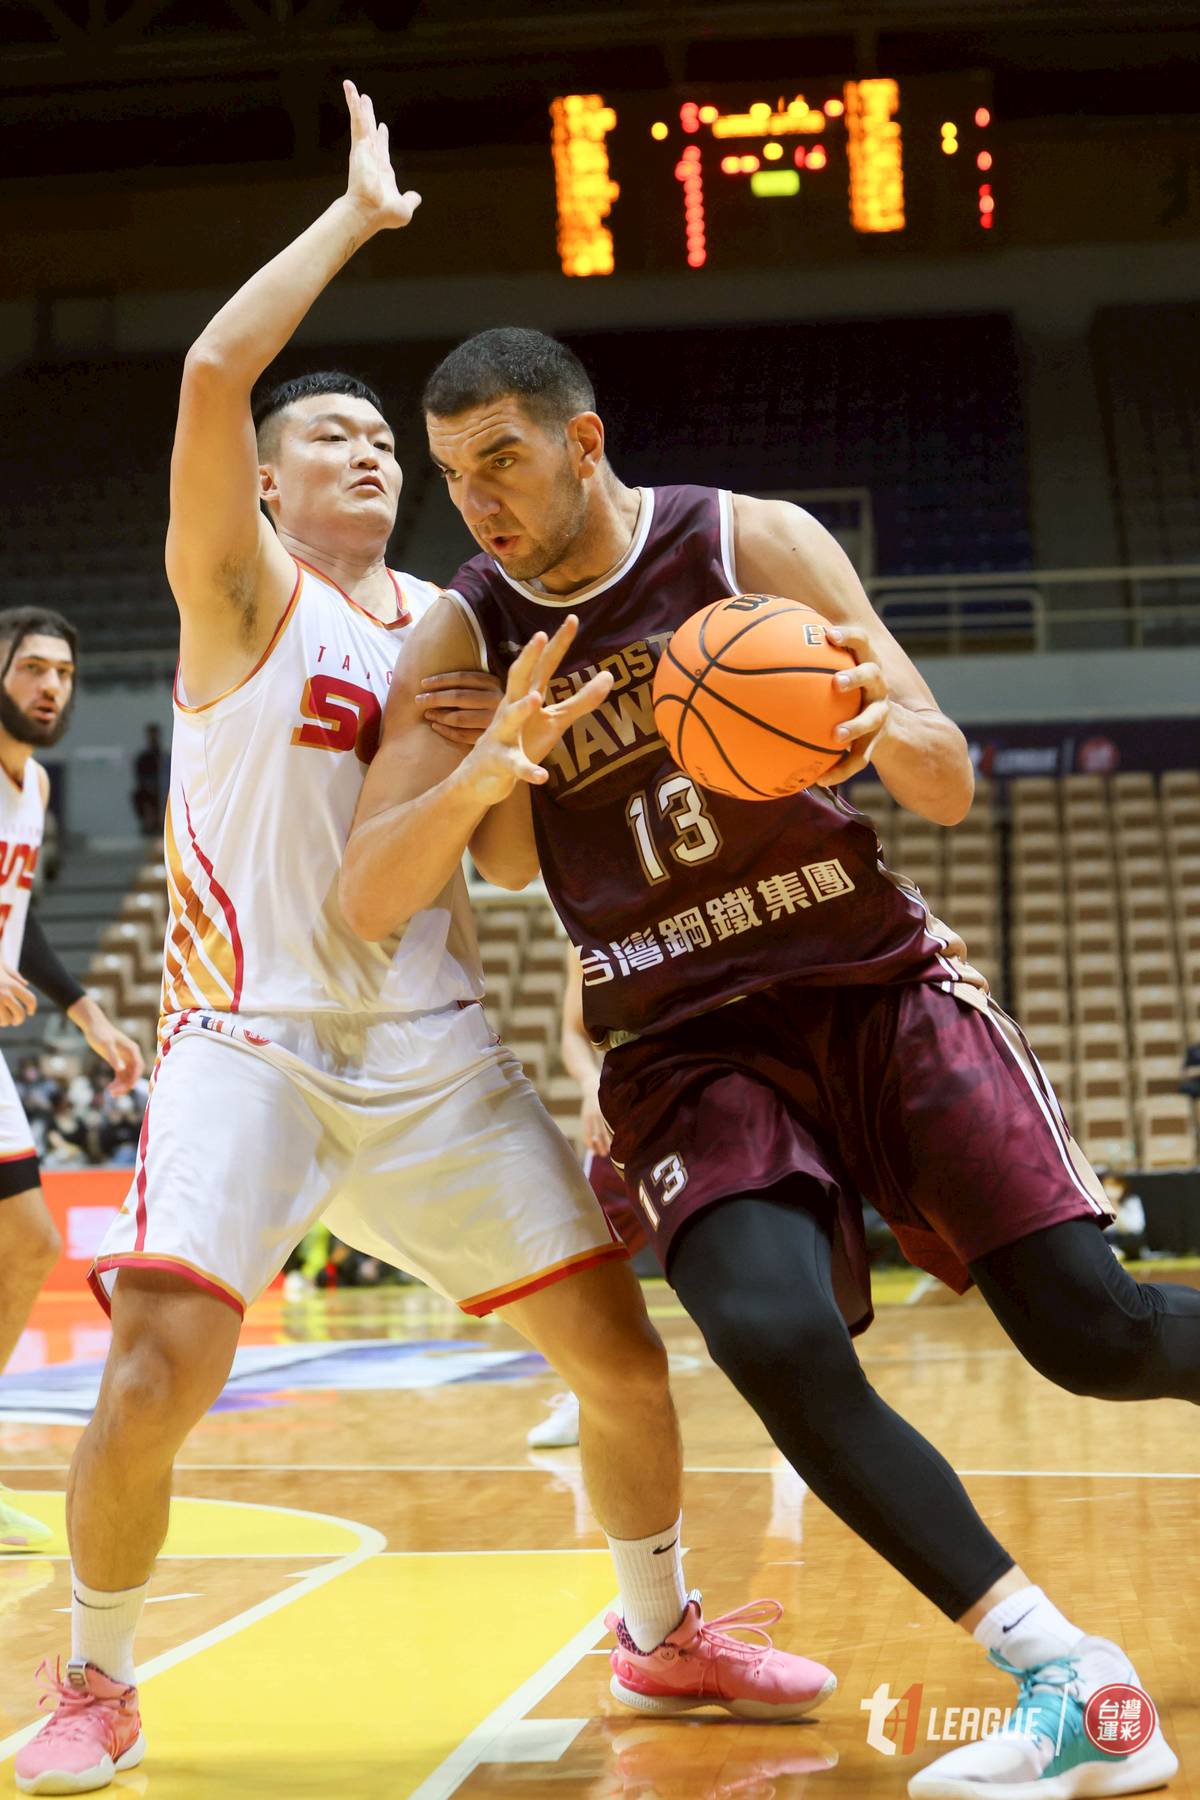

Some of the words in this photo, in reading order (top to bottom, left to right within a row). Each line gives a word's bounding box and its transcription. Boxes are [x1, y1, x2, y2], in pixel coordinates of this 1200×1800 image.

[625, 770, 723, 886] 13
[575, 858, 856, 986] 台灣鋼鐵集團
[639, 1151, 689, 1232] 13
